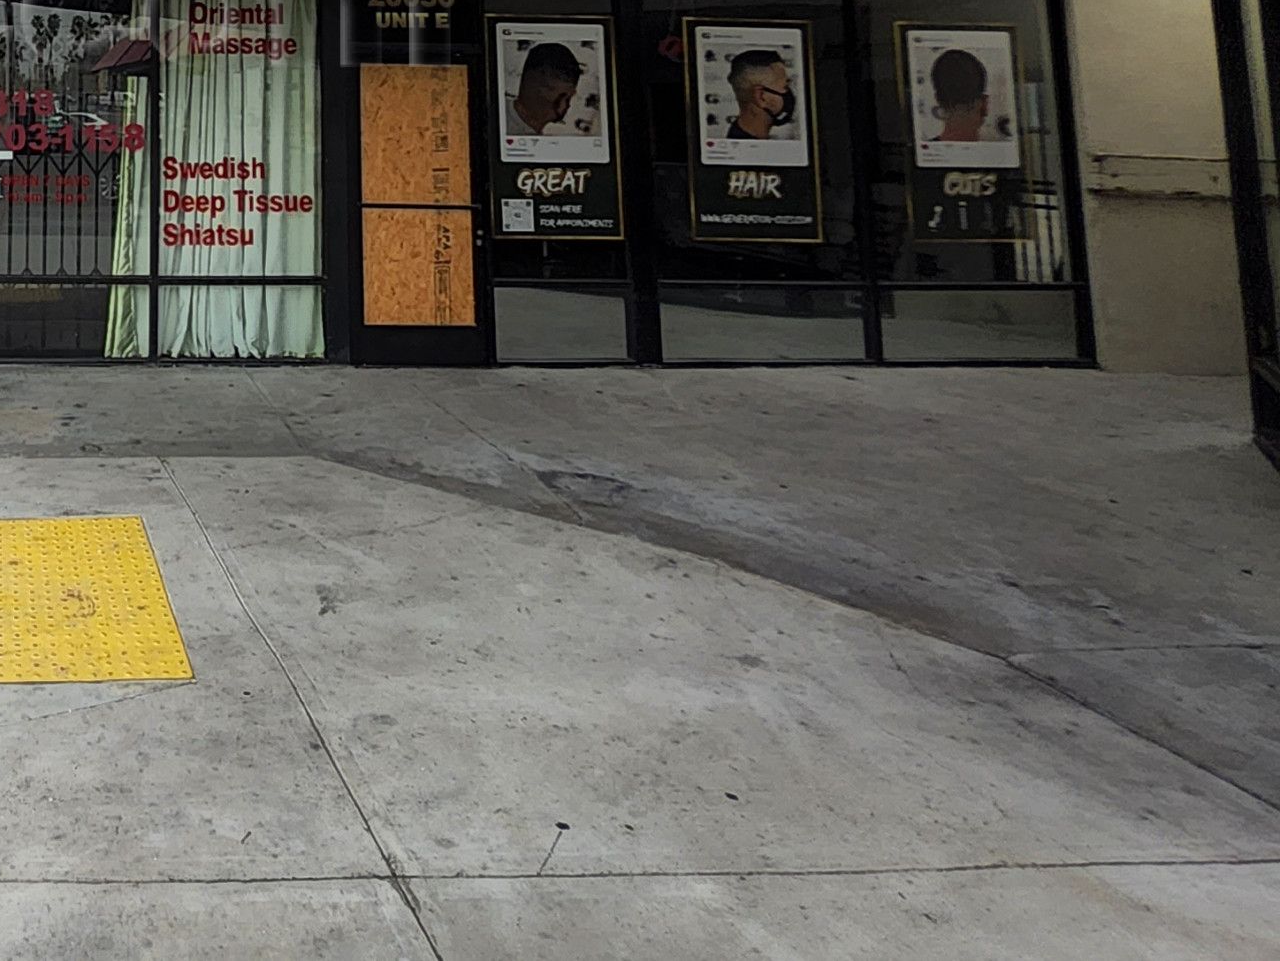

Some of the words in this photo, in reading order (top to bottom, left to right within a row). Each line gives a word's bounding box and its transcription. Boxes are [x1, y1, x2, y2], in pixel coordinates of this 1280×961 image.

[189, 1, 285, 26] Oriental
[375, 11, 429, 29] UNIT
[435, 11, 450, 29] E
[189, 30, 298, 60] Massage
[162, 155, 266, 180] Swedish
[517, 168, 591, 197] GREAT
[728, 170, 783, 198] HAIR
[163, 189, 226, 219] Deep
[232, 189, 313, 213] Tissue
[162, 222, 255, 247] Shiatsu
